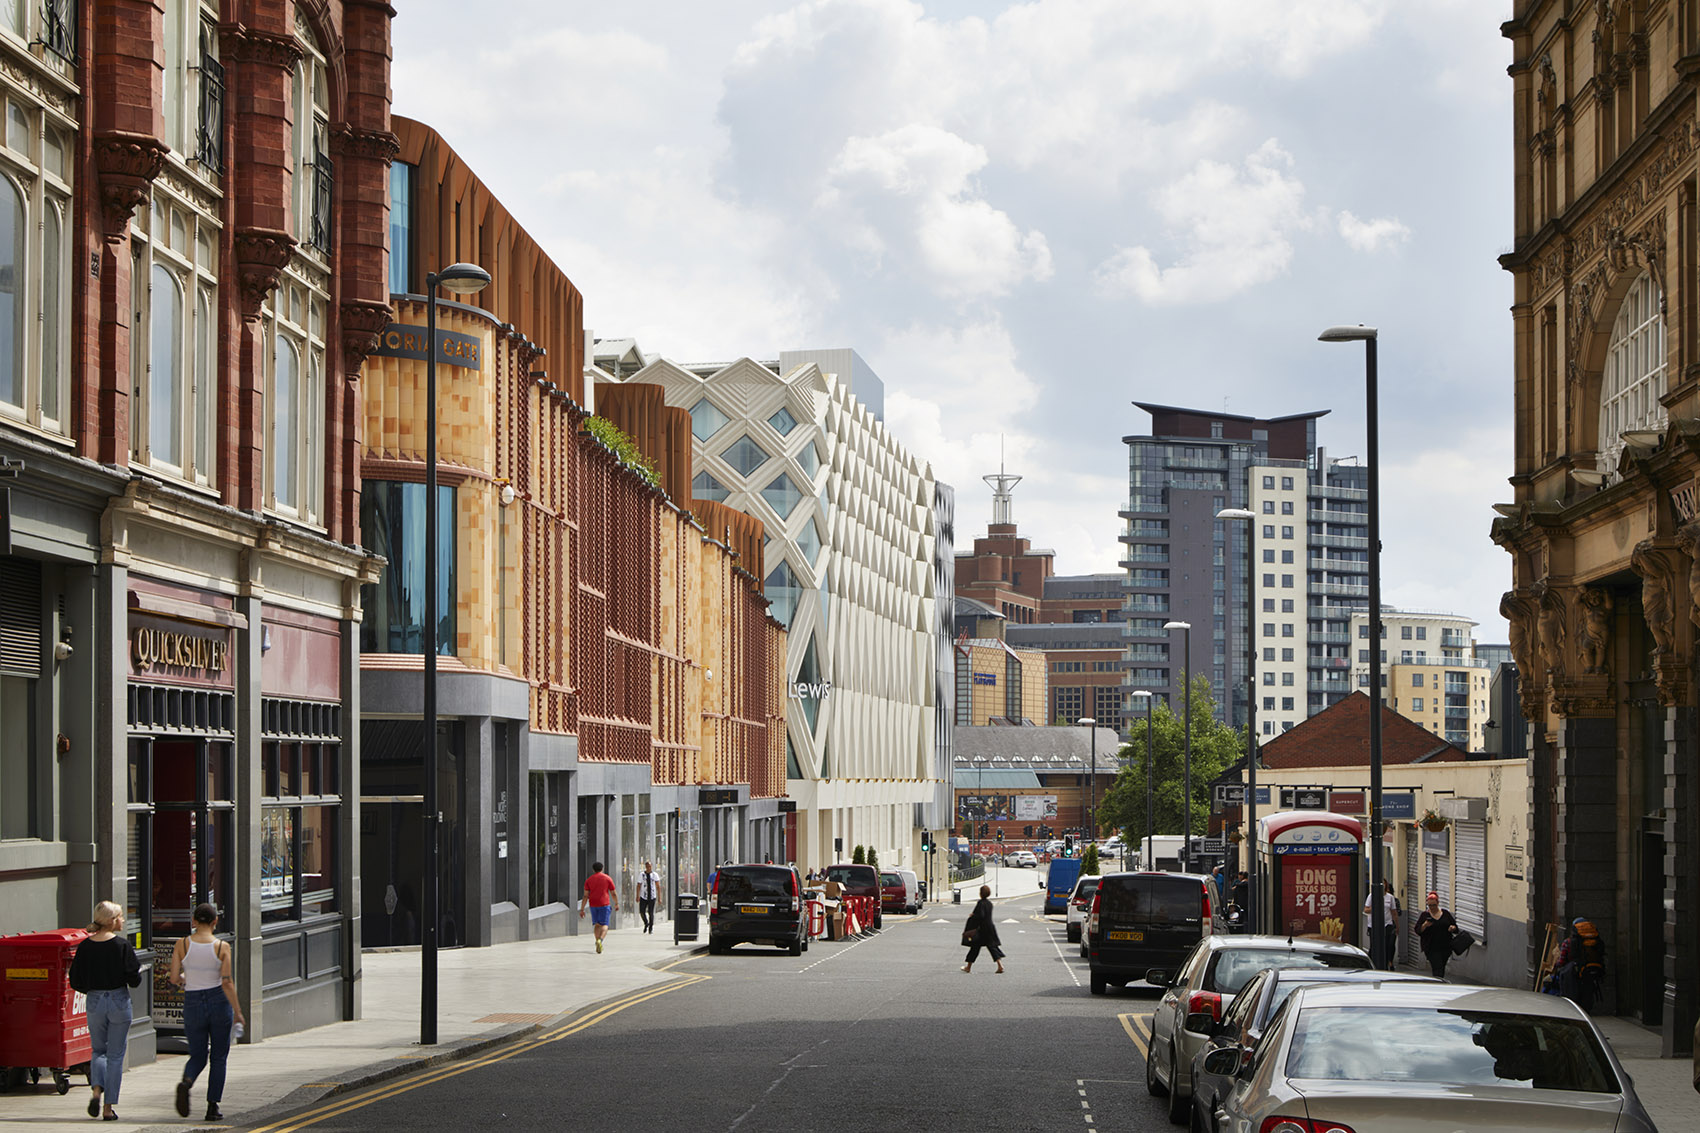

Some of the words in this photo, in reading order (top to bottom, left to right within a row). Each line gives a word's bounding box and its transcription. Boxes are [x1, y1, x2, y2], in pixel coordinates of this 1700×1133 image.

[443, 337, 477, 361] GATE
[137, 627, 228, 671] QUICKSILVER
[788, 673, 830, 699] Lewis
[1295, 869, 1337, 885] LONG
[1295, 885, 1319, 894] TEXAS
[1320, 885, 1337, 894] BBQ
[1295, 894, 1337, 915] £1.99
